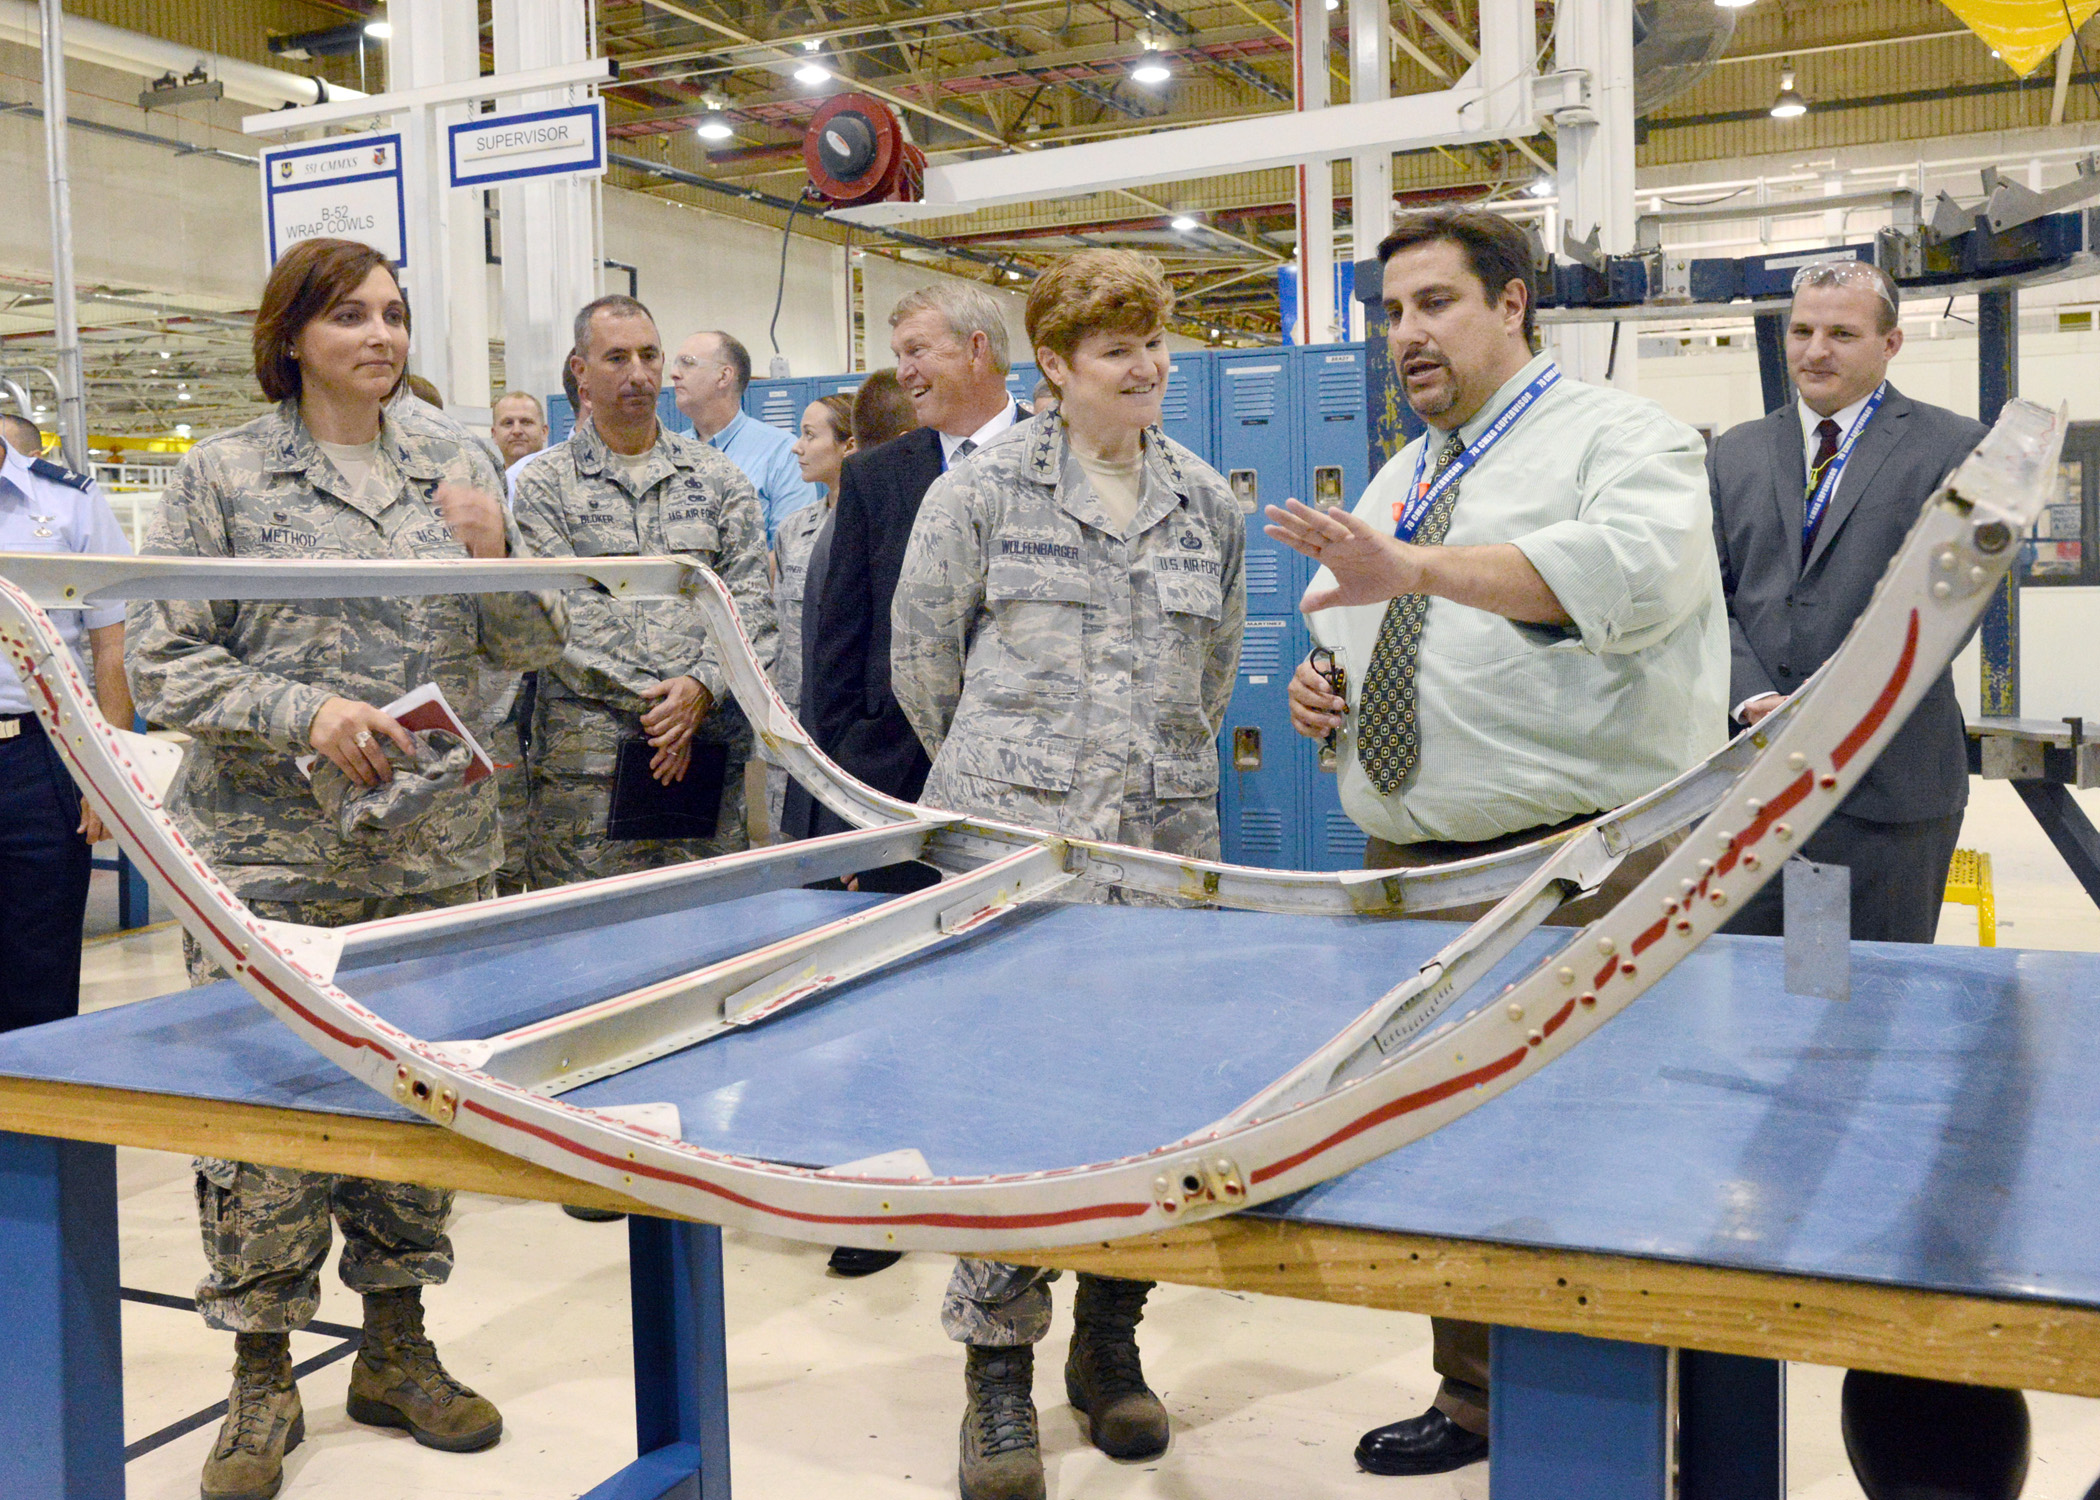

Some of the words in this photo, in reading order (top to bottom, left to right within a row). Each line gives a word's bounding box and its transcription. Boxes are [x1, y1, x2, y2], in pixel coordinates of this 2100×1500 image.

[476, 126, 569, 150] SUPERVISOR
[304, 163, 318, 174] 551
[320, 157, 358, 172] CMMXS
[321, 205, 349, 221] B-52
[285, 222, 324, 239] WRAP
[327, 215, 375, 233] COWLS
[1469, 446, 1480, 457] 76
[1479, 429, 1498, 449] CMXG
[1495, 391, 1533, 432] SUPERVISOR
[1404, 520, 1415, 532] 76
[1411, 499, 1429, 522] CMXG
[1426, 461, 1464, 502] SUPERVISOR
[1817, 468, 1838, 503] SUPERVISOR
[261, 528, 317, 547] METHOD
[1001, 540, 1079, 560] WOLFENBARGER
[1160, 558, 1182, 571] U.S.
[1183, 558, 1200, 572] AIR
[1201, 560, 1220, 577] FORC
